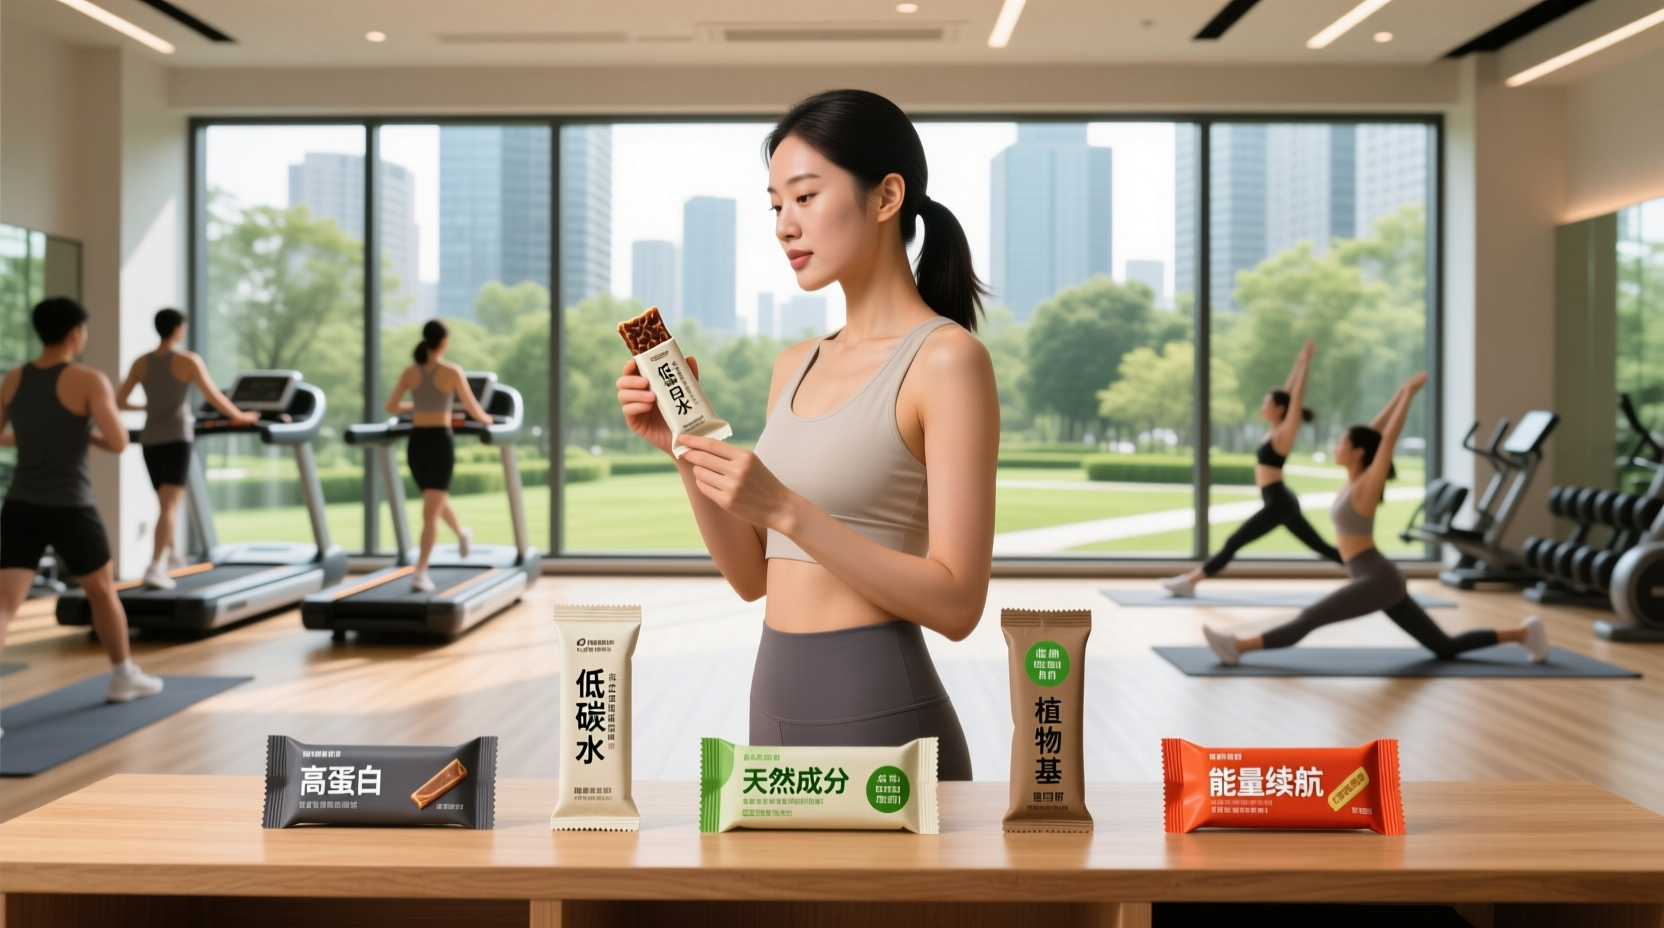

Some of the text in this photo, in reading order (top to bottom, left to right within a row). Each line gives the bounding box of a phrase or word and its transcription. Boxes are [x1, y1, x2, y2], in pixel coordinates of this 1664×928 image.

[575, 668, 606, 765] 低碳水
[1034, 696, 1062, 785] 植物基
[300, 765, 382, 796] 高蛋白
[742, 767, 850, 795] 天然成分
[1208, 765, 1325, 798] 能量续航
